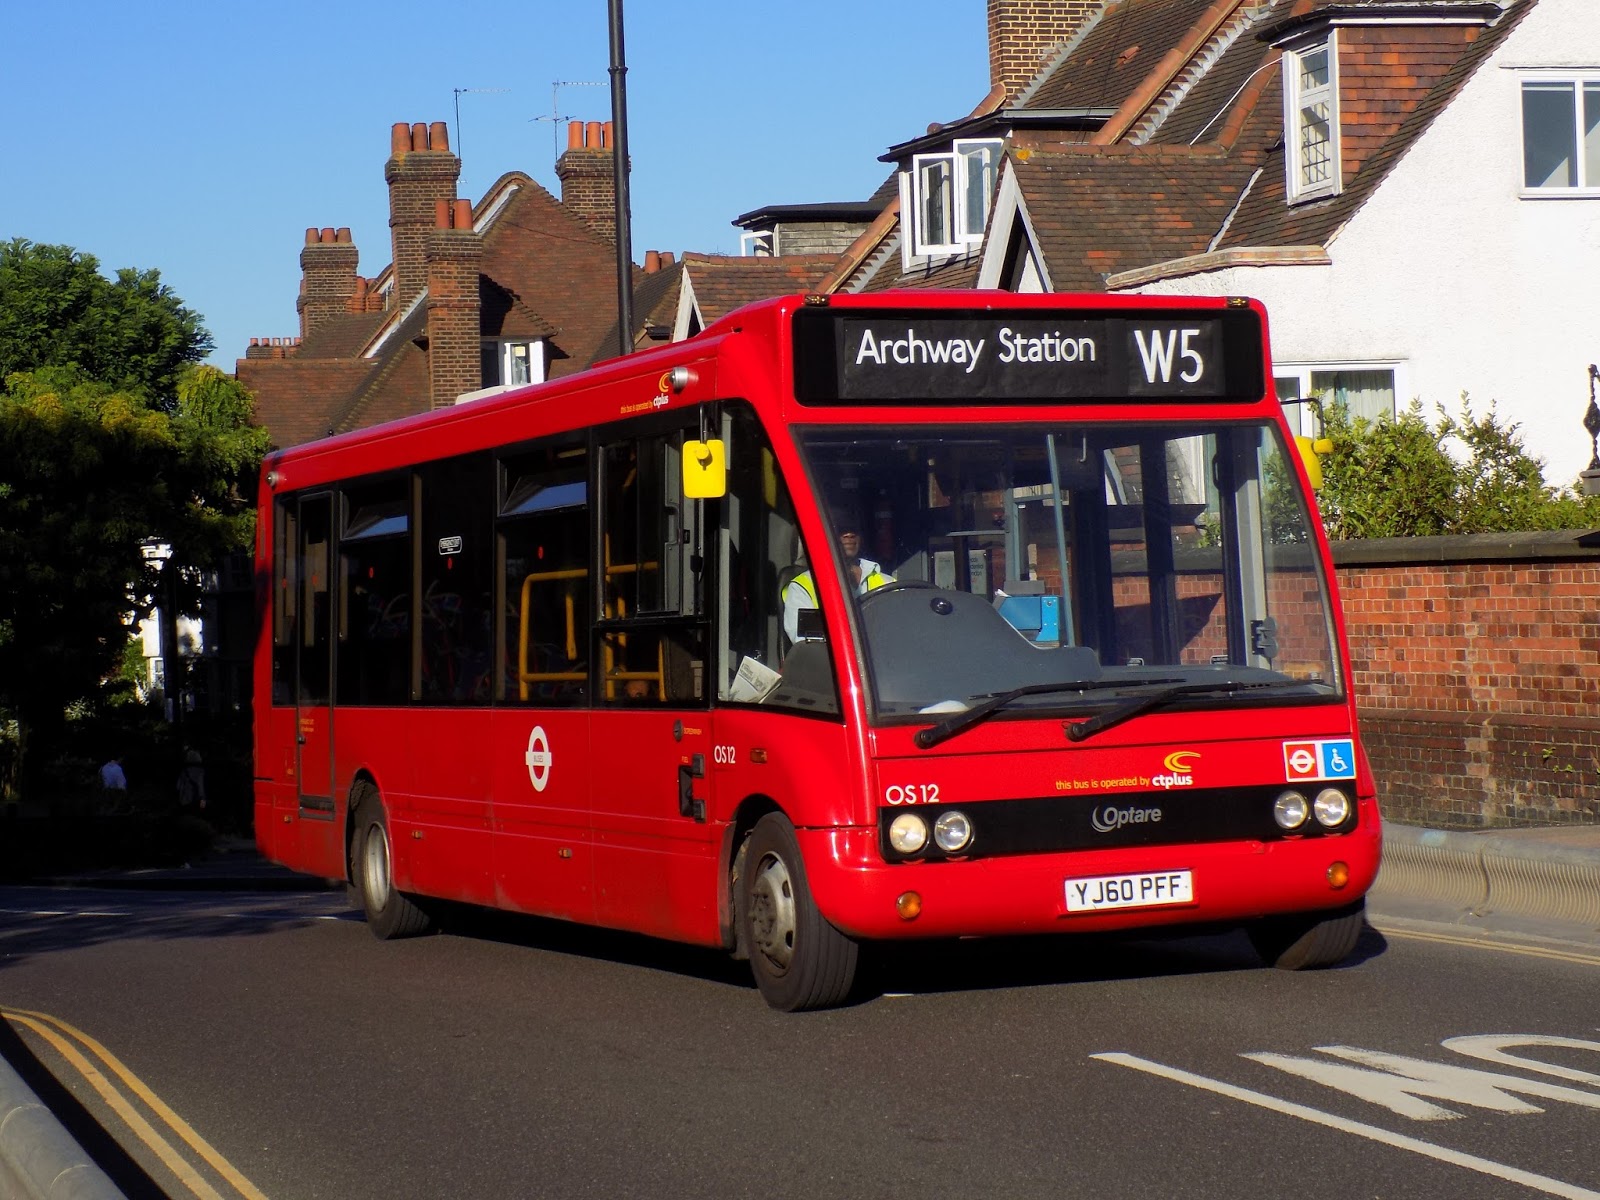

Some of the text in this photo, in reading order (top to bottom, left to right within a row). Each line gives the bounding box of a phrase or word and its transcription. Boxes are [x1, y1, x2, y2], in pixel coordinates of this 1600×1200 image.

[856, 327, 1096, 373] Archway Station
[1134, 328, 1204, 384] W5
[713, 745, 736, 764] OS12
[1055, 772, 1193, 790] this bus is operated by ctplus
[1103, 806, 1162, 829] Optare
[1075, 875, 1181, 905] YJ60 PFF
